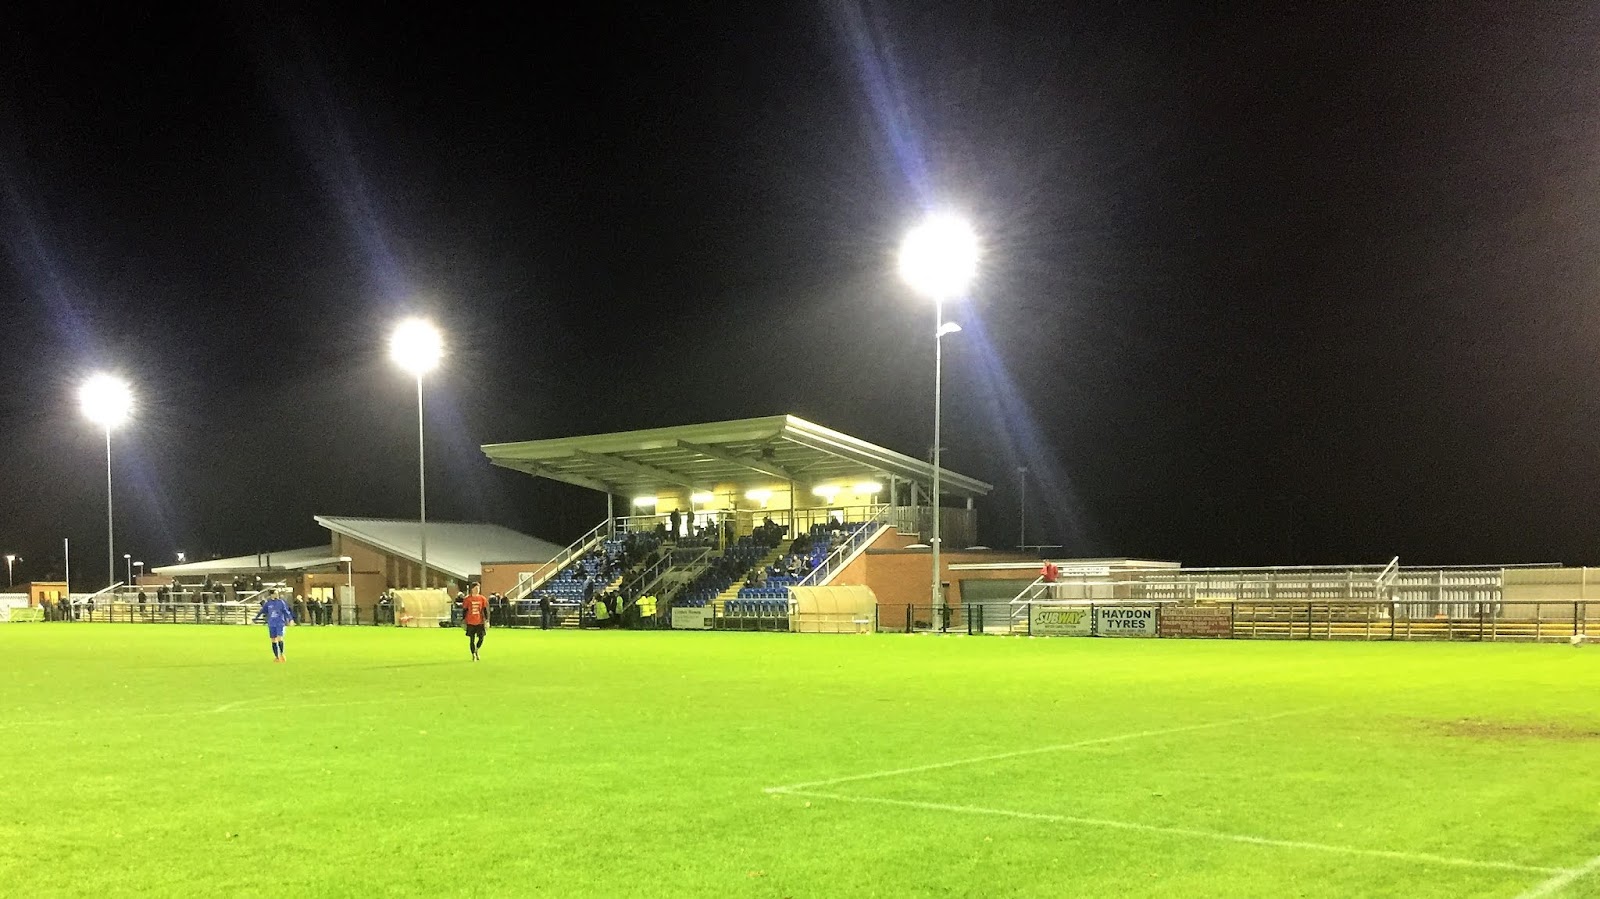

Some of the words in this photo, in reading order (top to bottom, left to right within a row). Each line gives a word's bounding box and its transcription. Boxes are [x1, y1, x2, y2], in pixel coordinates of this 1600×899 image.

[1035, 611, 1085, 625] SUBWAY
[1102, 609, 1151, 619] HAYDON
[1107, 619, 1146, 628] TYRES
